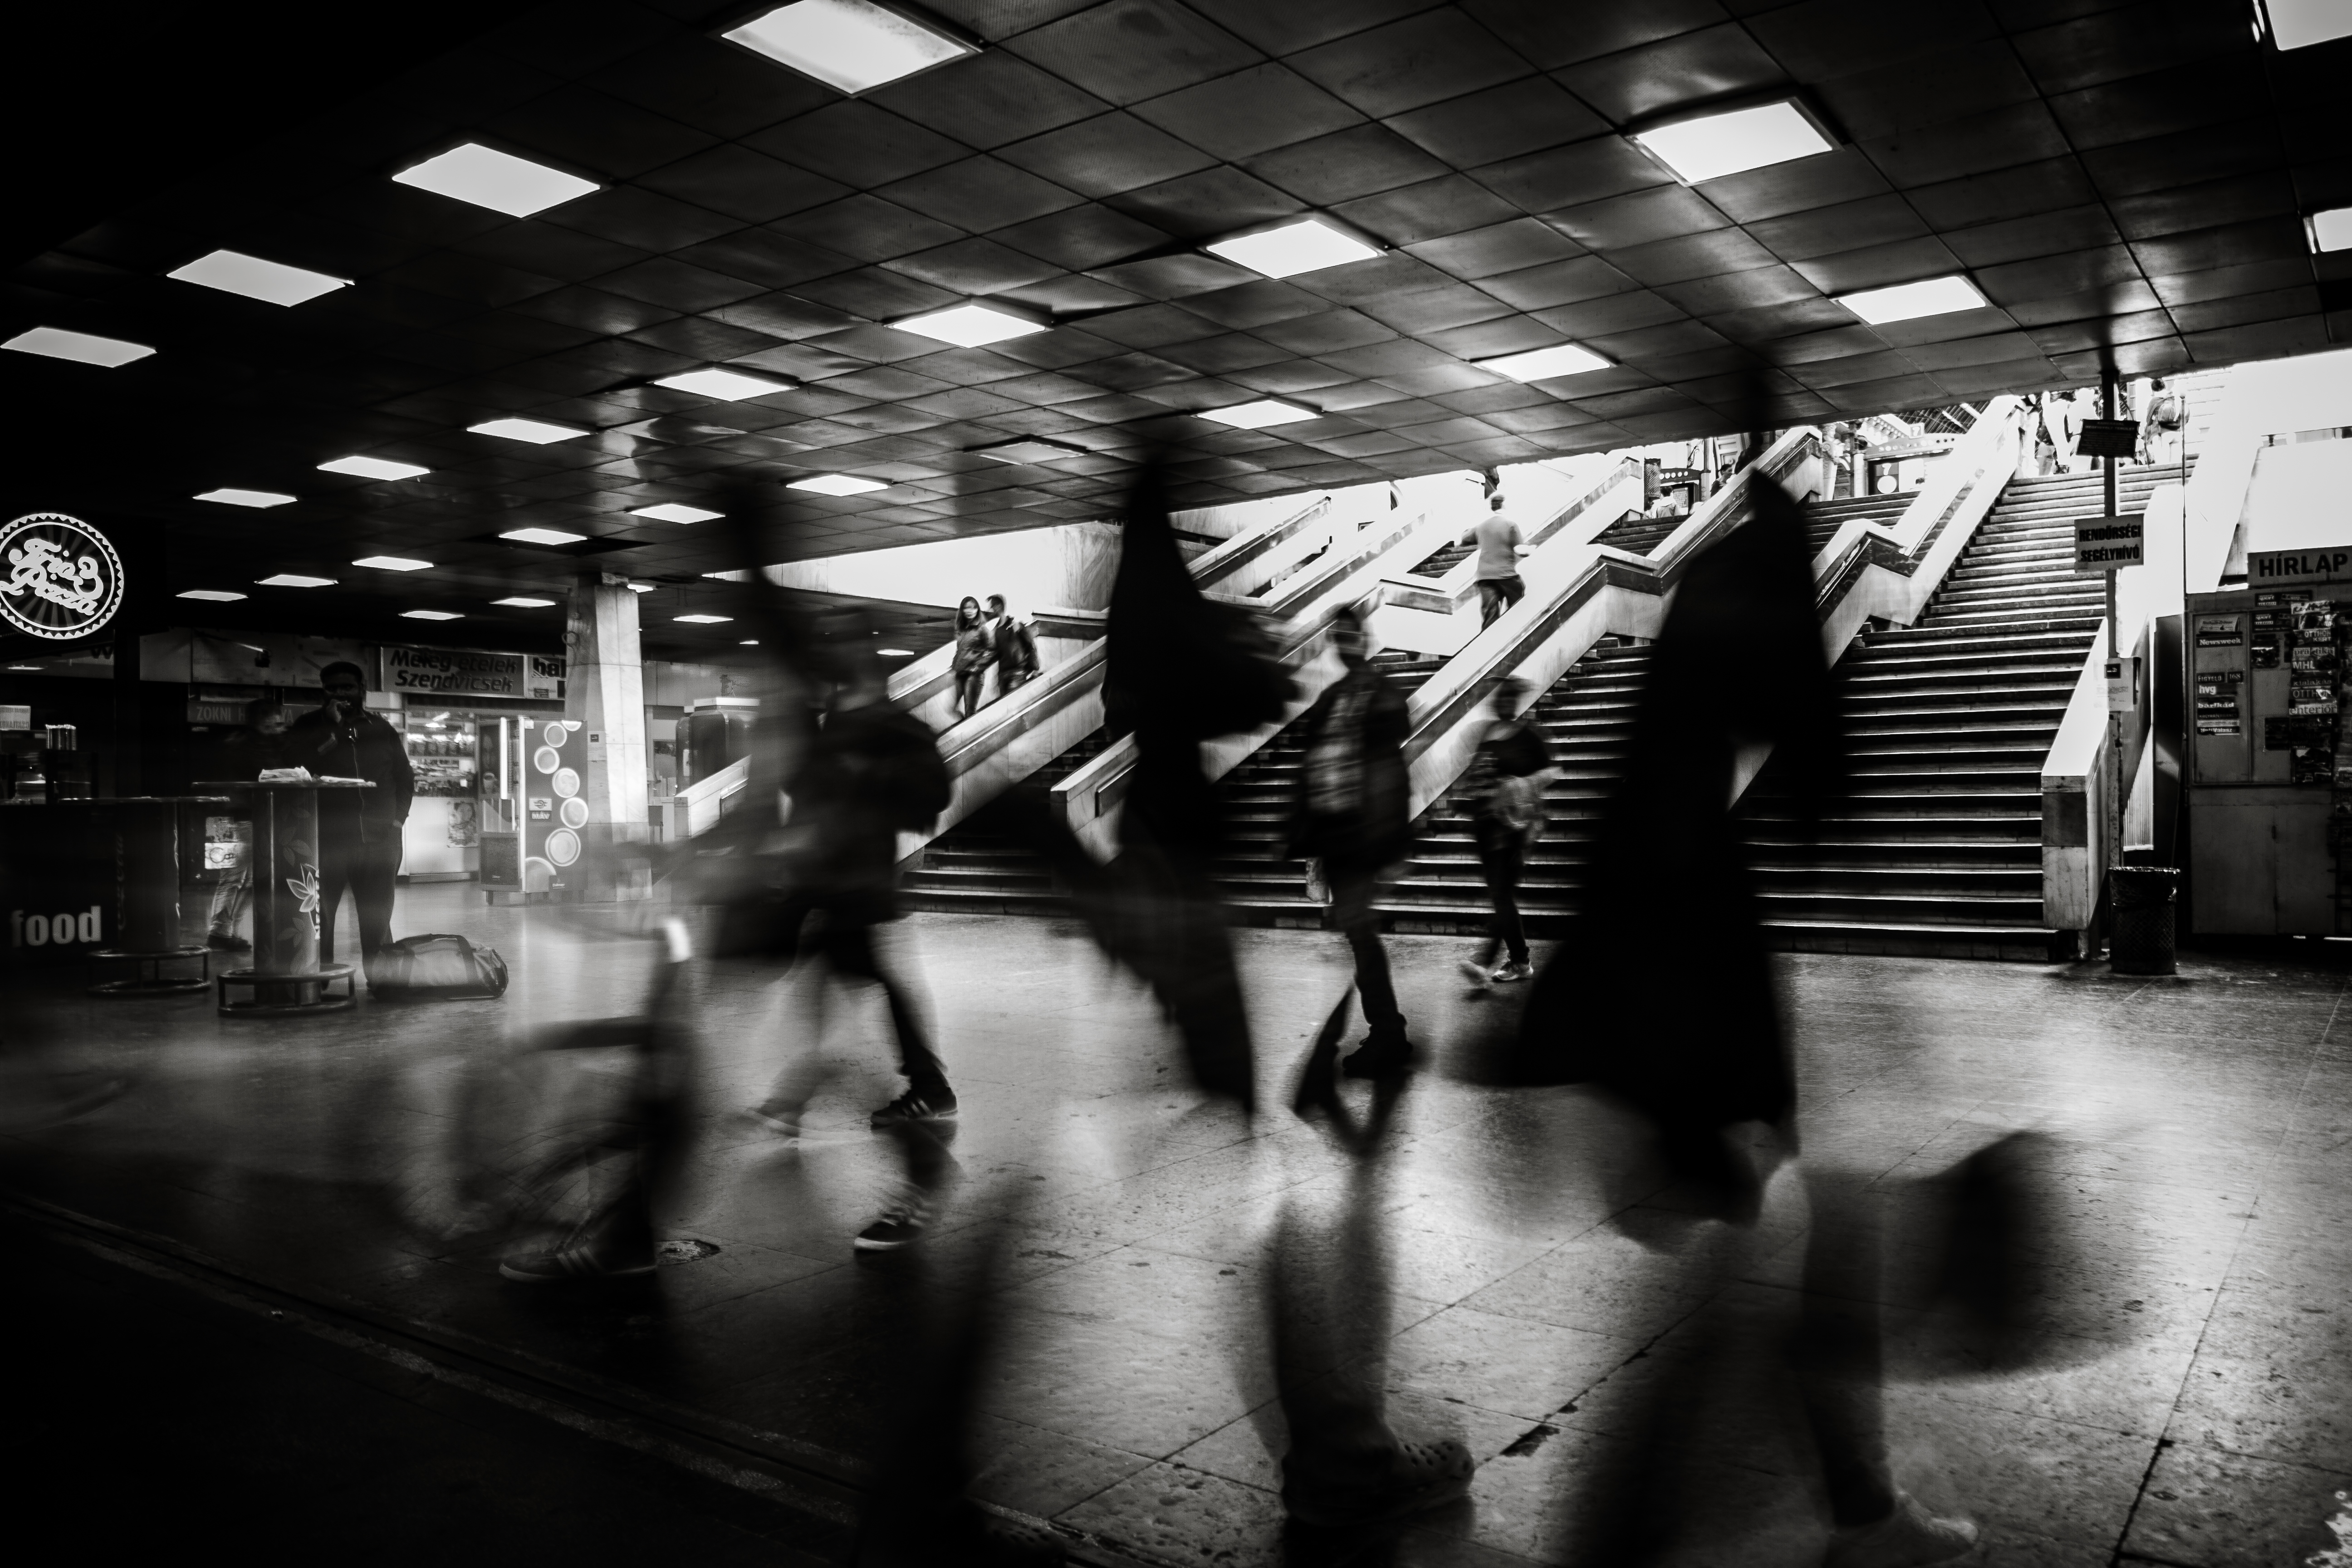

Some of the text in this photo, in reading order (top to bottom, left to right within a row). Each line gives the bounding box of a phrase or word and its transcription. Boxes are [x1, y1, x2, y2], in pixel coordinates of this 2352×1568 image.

[1882, 463, 1891, 476] 7
[2079, 523, 2141, 542] RENDŐRSÉGI
[2080, 544, 2139, 562] SEGÉLYHÍVÓ
[2259, 553, 2348, 578] HÍRLAP
[2199, 637, 2241, 646] Newsweek
[390, 650, 452, 672] Meleg
[395, 669, 514, 693] Szendvicsek
[2199, 685, 2216, 695] hvg
[196, 706, 231, 721] ZOKNI
[10, 905, 102, 947] food
